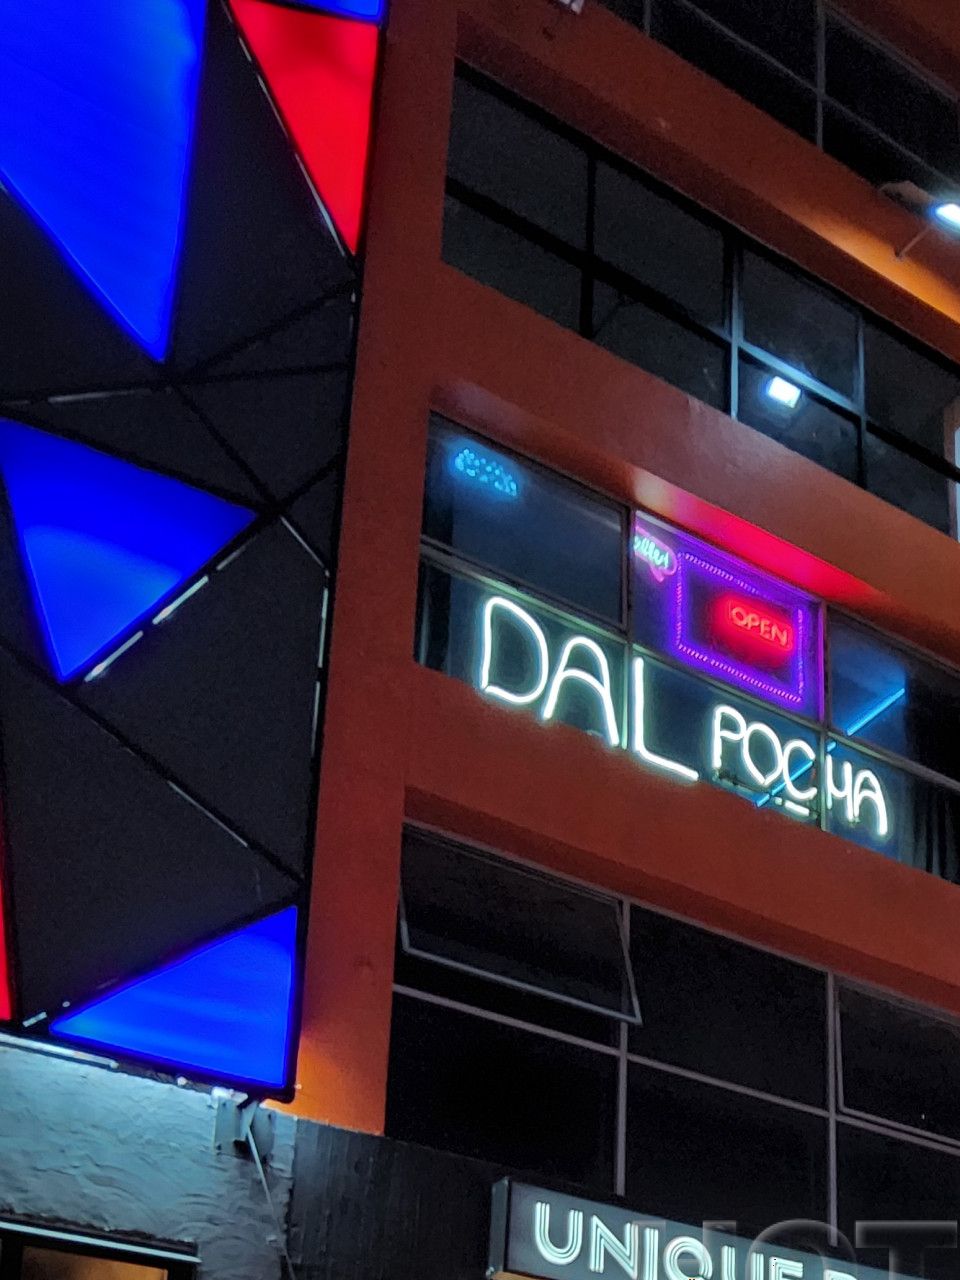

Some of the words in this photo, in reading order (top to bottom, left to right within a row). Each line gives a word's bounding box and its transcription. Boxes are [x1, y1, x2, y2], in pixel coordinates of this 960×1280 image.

[731, 604, 789, 648] OPEN
[480, 596, 701, 783] DAL
[712, 704, 890, 838] POCHA
